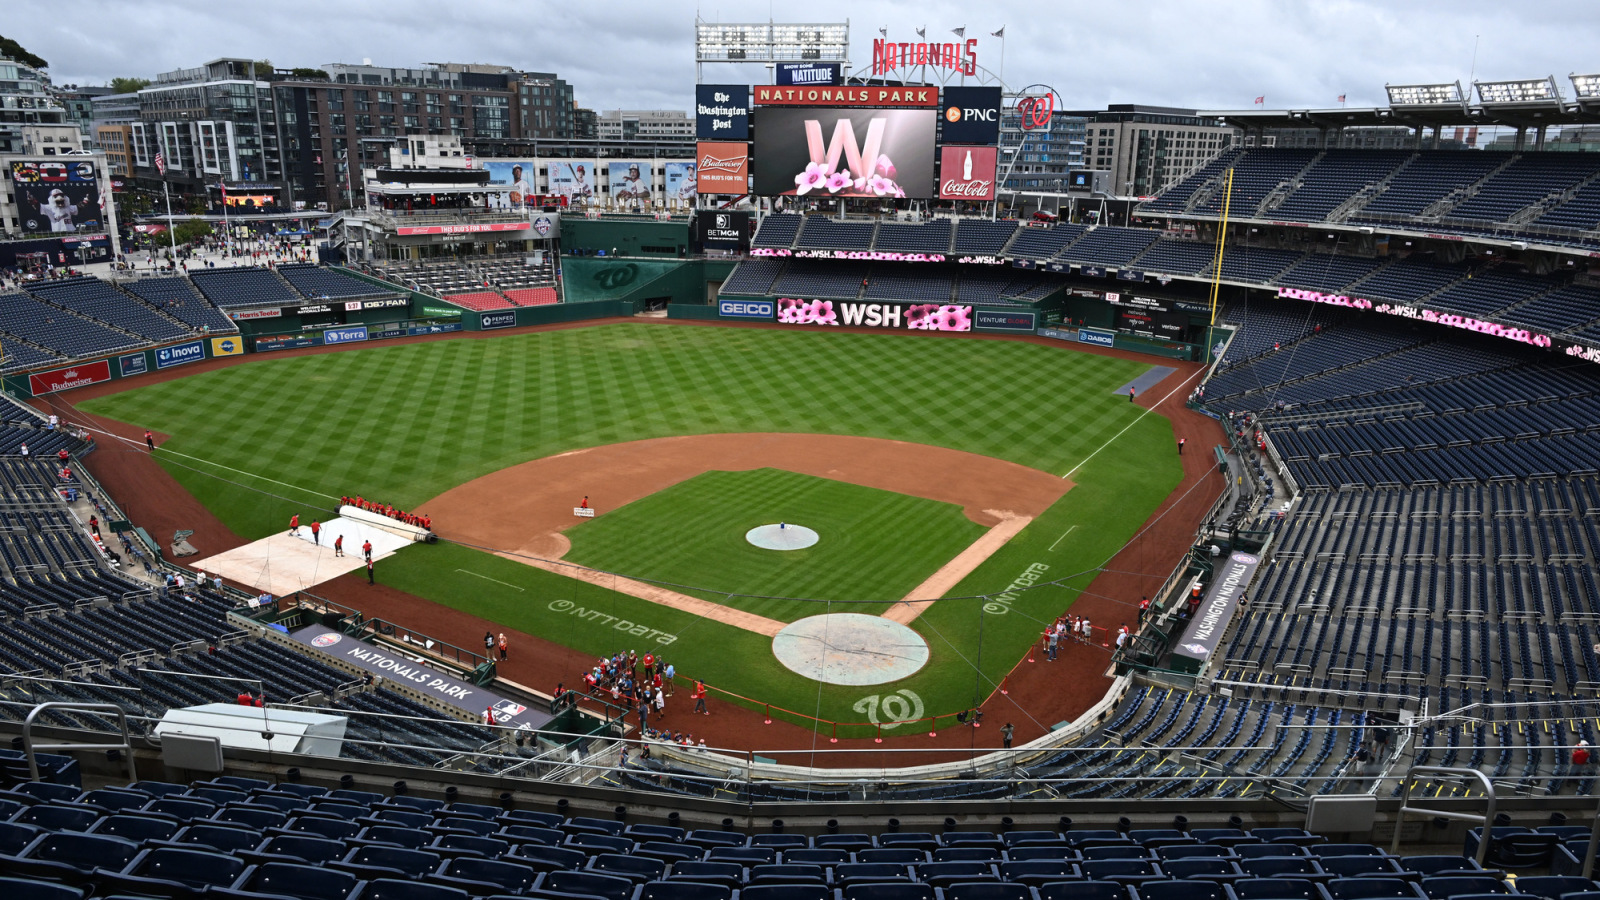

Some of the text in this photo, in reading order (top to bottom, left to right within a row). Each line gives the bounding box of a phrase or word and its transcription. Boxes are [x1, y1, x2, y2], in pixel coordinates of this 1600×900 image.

[873, 38, 977, 76] NATIONALS
[792, 68, 832, 82] NATITUDE
[714, 92, 730, 103] The
[760, 90, 928, 102] NATIONALS PARK
[698, 104, 747, 117] Washington
[963, 108, 997, 121] PNC
[713, 119, 732, 131] Post
[804, 118, 887, 180] W
[702, 159, 742, 168] Budweiser
[942, 179, 992, 196] Coca-Cola
[811, 250, 830, 258] WSH
[976, 255, 996, 264] WSH
[239, 310, 280, 319] Harris Teeter
[721, 303, 772, 315] GEICO
[839, 303, 901, 327] WSH
[1394, 305, 1418, 318] WSH
[338, 331, 364, 340] Terra
[172, 345, 200, 358] Inova
[51, 377, 92, 391] Budweiser
[1193, 563, 1248, 640] WASHINGTON NATIONALS
[347, 647, 473, 700] NATIONALS PARK
